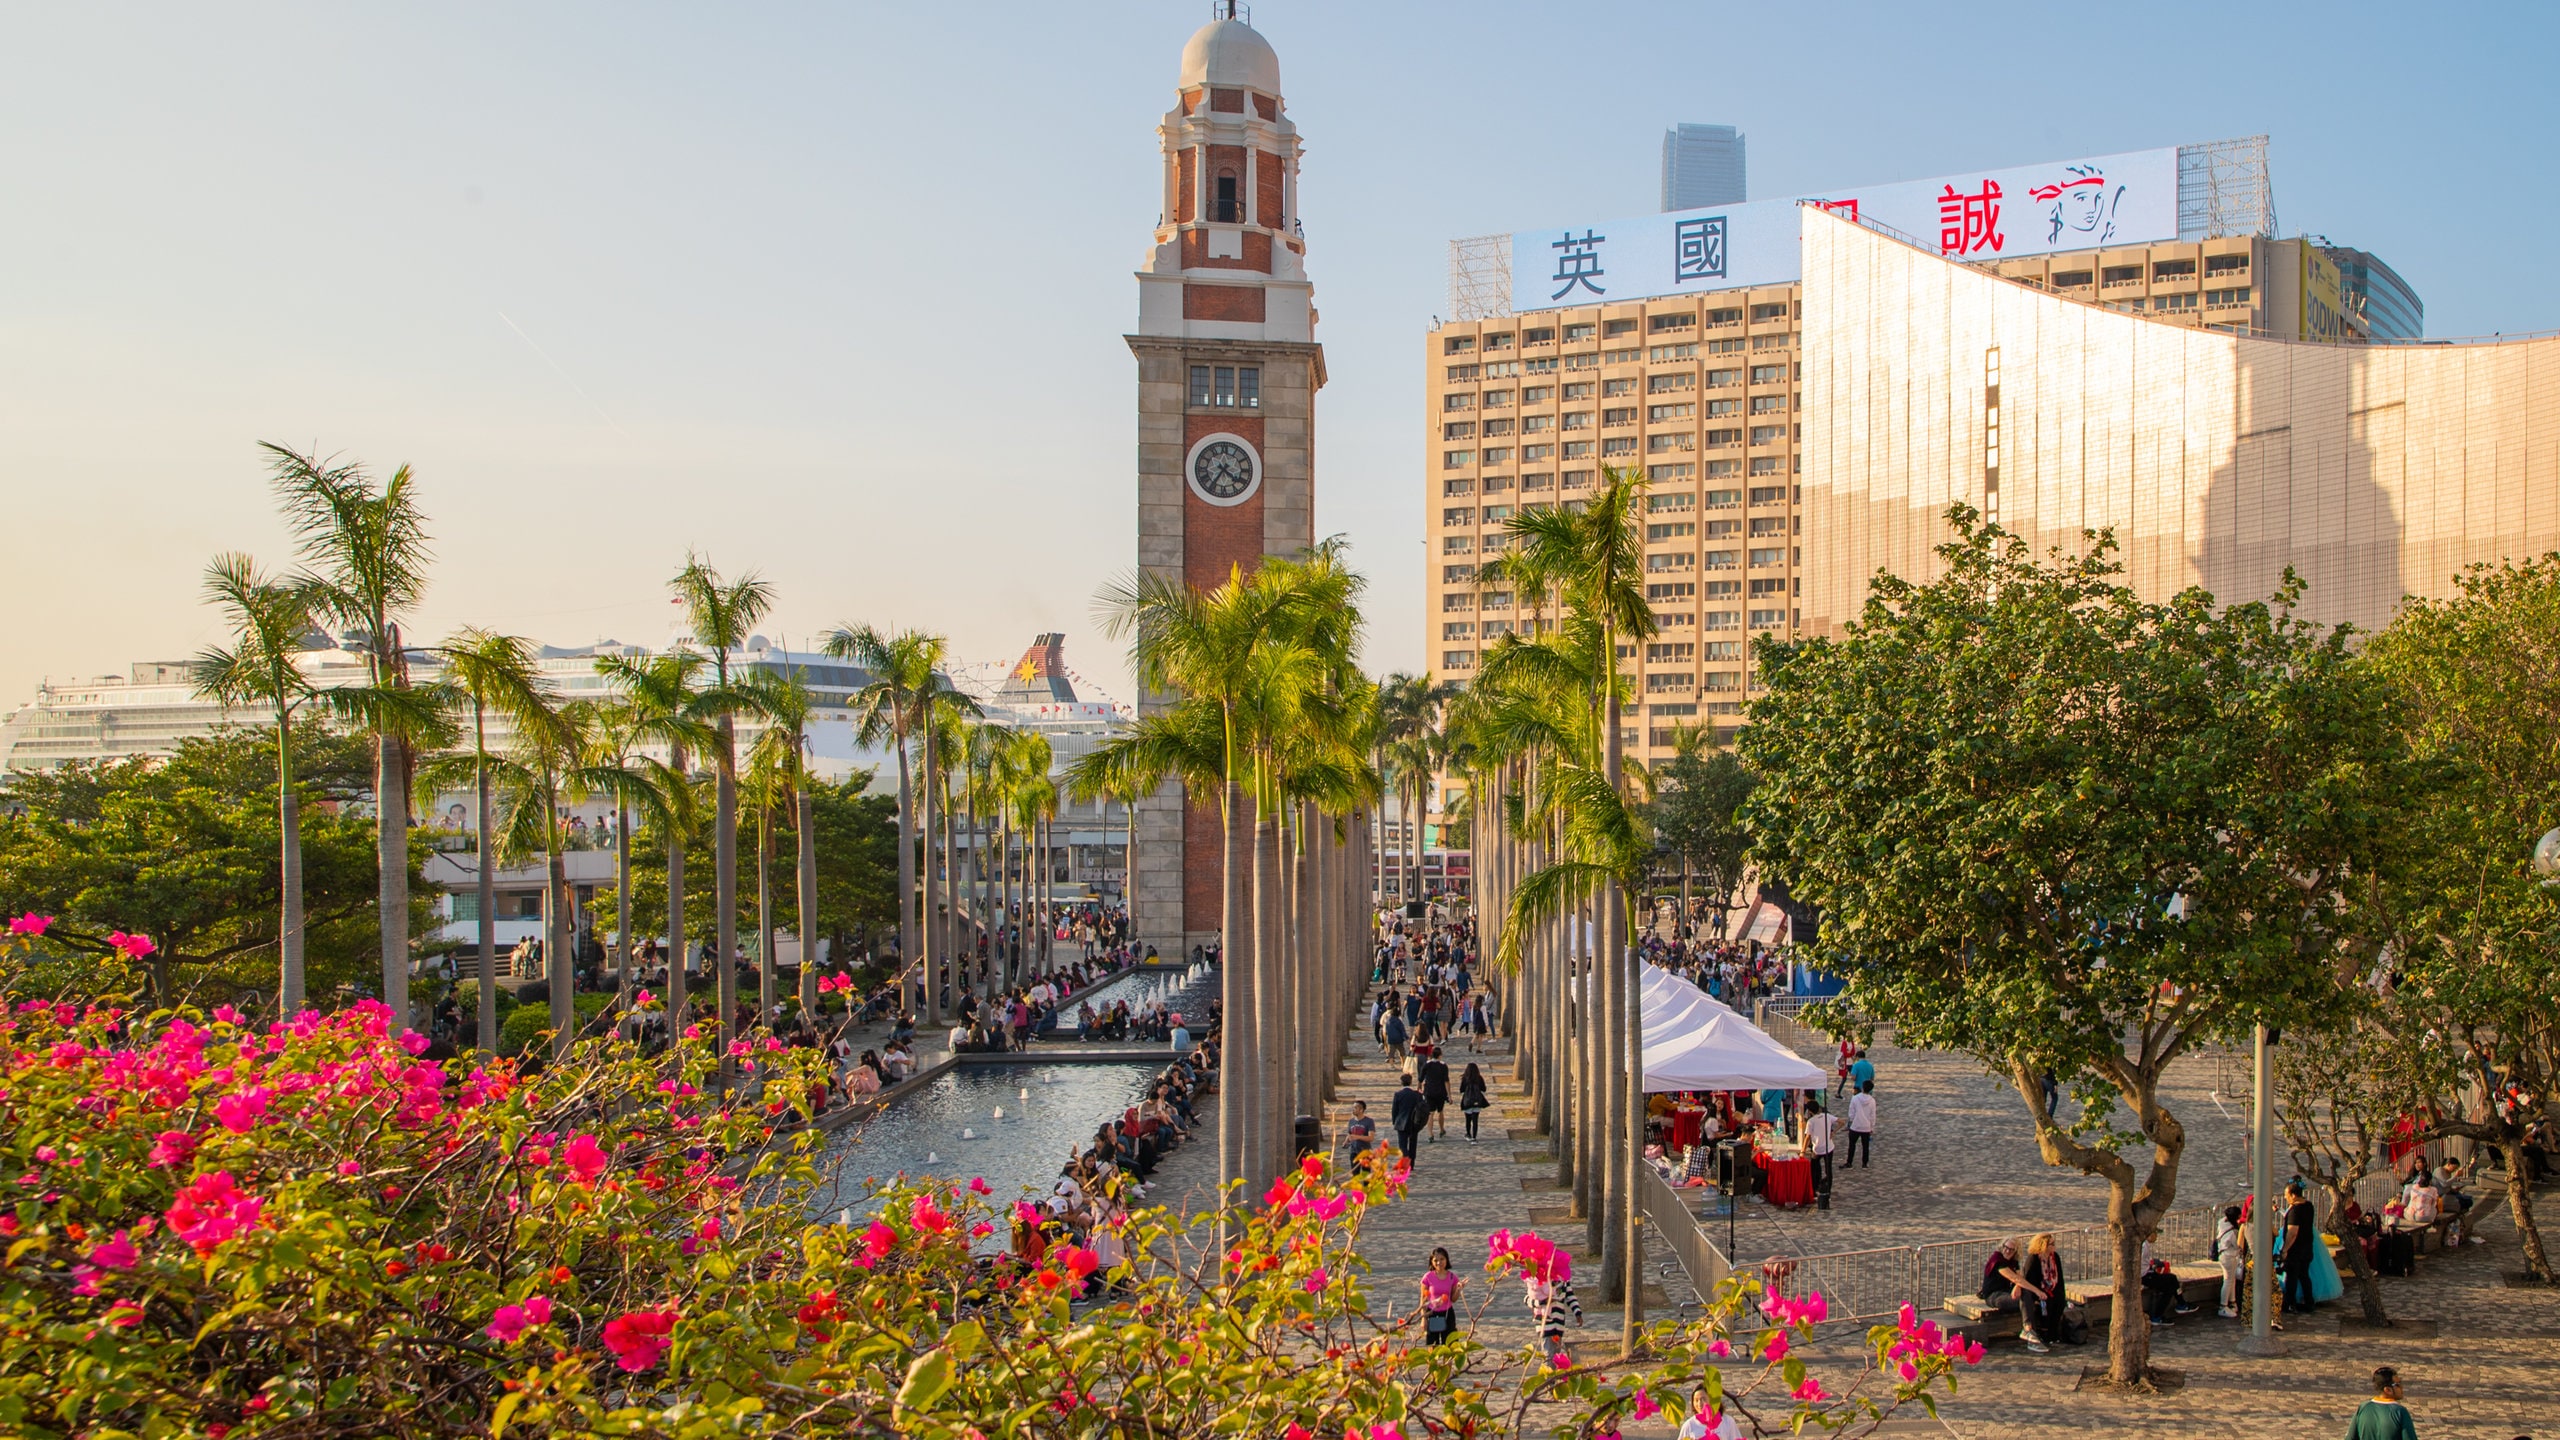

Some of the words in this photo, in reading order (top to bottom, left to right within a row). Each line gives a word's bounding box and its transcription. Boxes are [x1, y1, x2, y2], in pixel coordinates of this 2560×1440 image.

[1551, 179, 2005, 301] 英國誠
[2307, 288, 2339, 338] BODW
